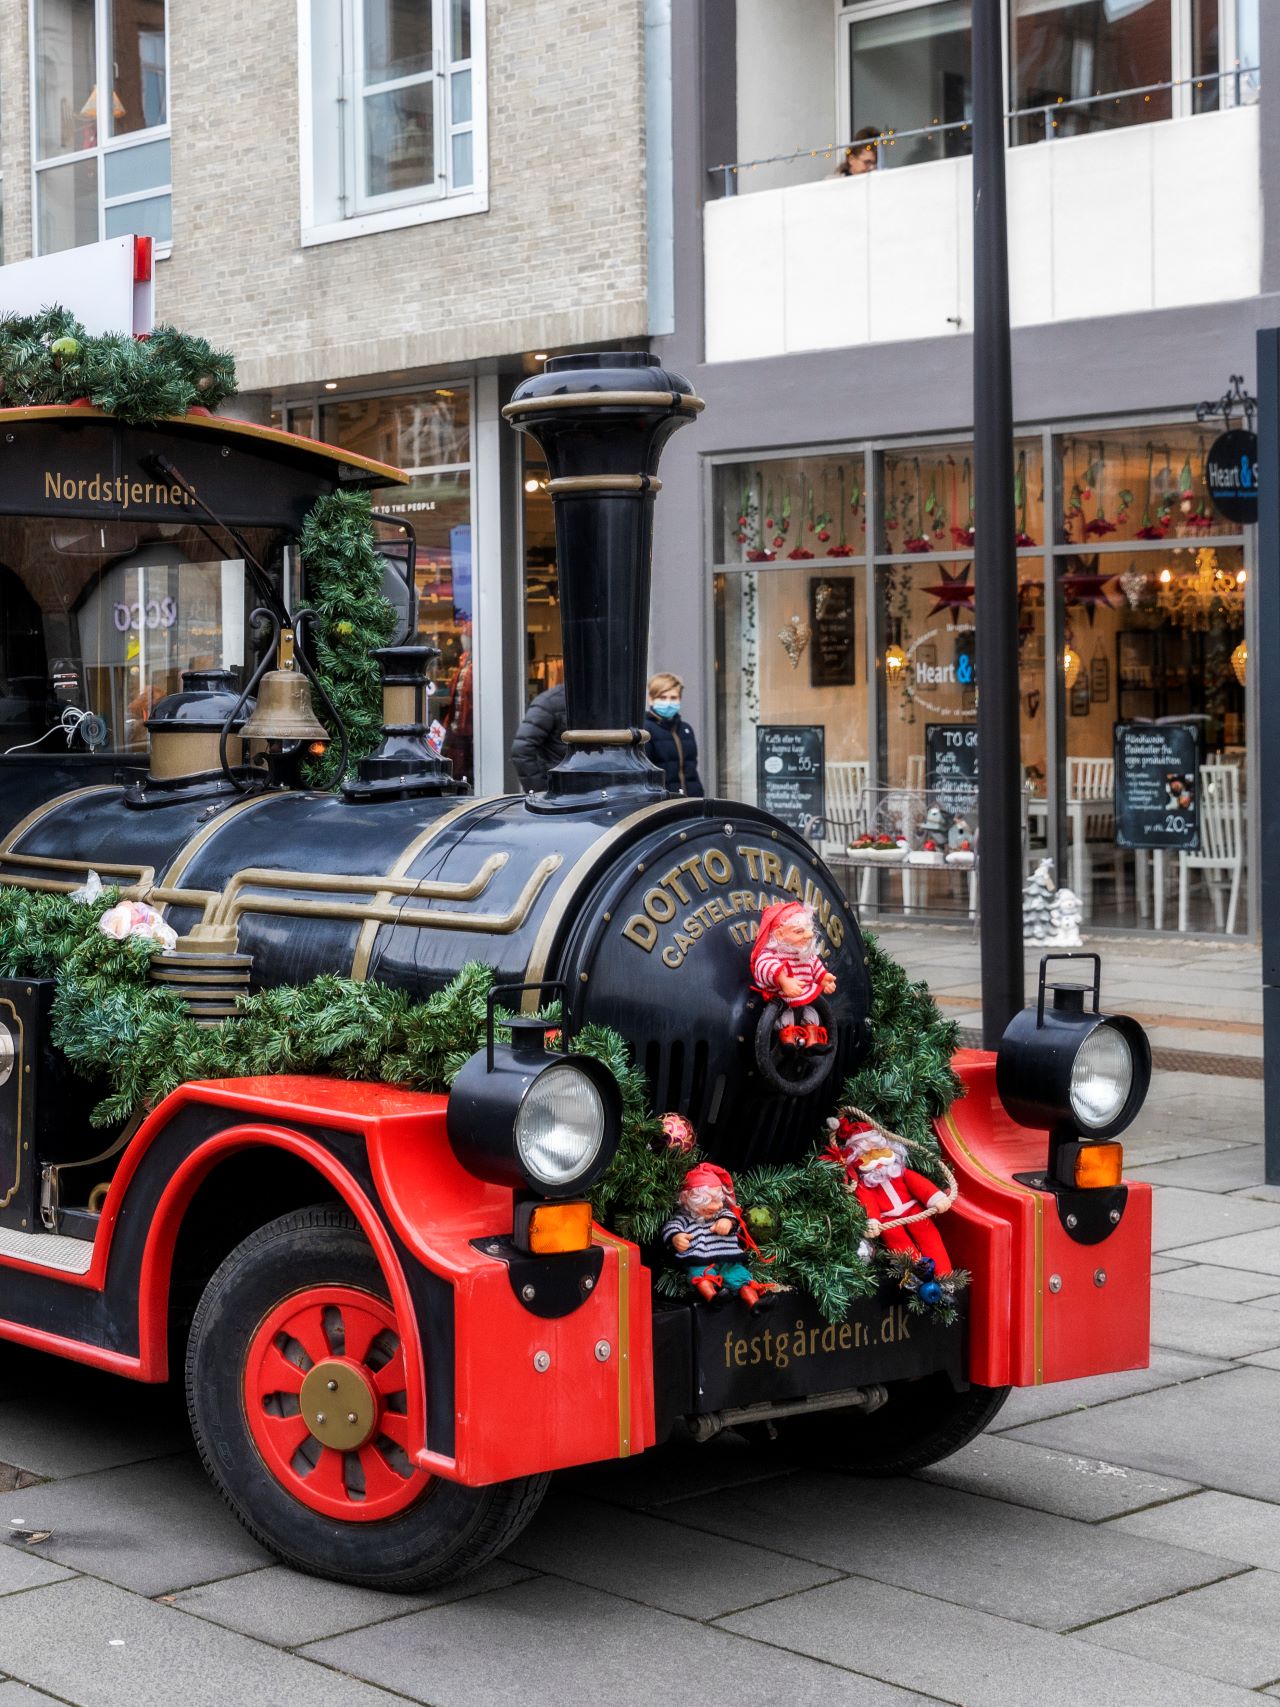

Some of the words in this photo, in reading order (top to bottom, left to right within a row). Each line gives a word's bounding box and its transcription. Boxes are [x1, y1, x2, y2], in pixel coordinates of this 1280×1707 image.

[1208, 463, 1240, 488] Heart
[1240, 455, 1253, 488] &
[45, 472, 197, 509] Nordstjernen
[380, 505, 390, 514] TO
[392, 503, 405, 513] THE
[407, 501, 436, 512] PEOPLE
[916, 661, 956, 684] Heart
[956, 654, 973, 684] &
[943, 731, 963, 747] TO
[1165, 814, 1194, 834] 20,-
[622, 848, 734, 953] DOTTO
[738, 846, 845, 949] TRAINS
[729, 920, 760, 947] ITA
